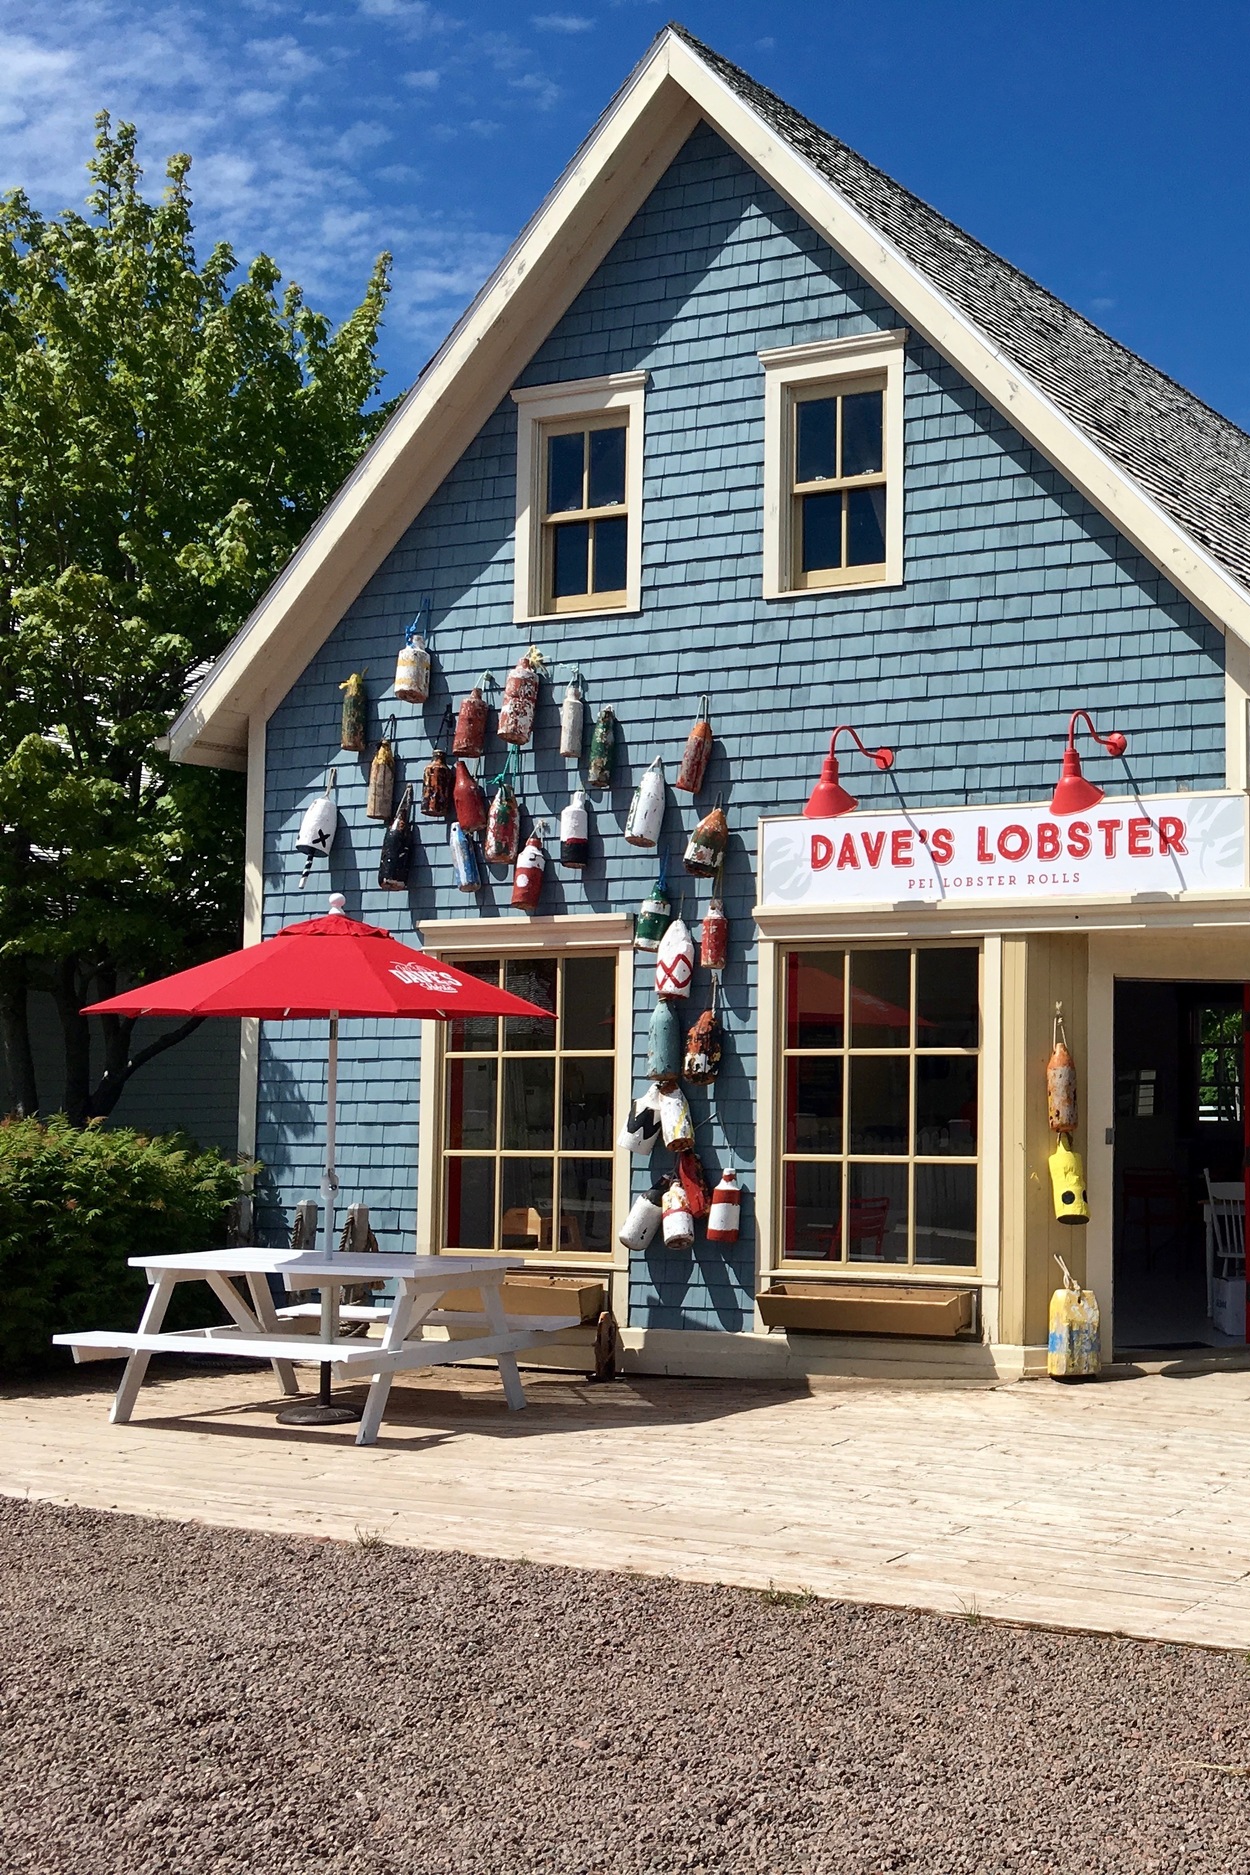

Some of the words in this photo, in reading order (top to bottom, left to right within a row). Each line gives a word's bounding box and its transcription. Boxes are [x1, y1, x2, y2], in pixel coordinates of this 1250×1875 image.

[811, 828, 955, 871] DAVE'S
[977, 816, 1189, 865] LOBSTER
[908, 878, 933, 889] PEI
[943, 876, 1017, 888] LOBSTER
[1027, 873, 1080, 885] ROLLS
